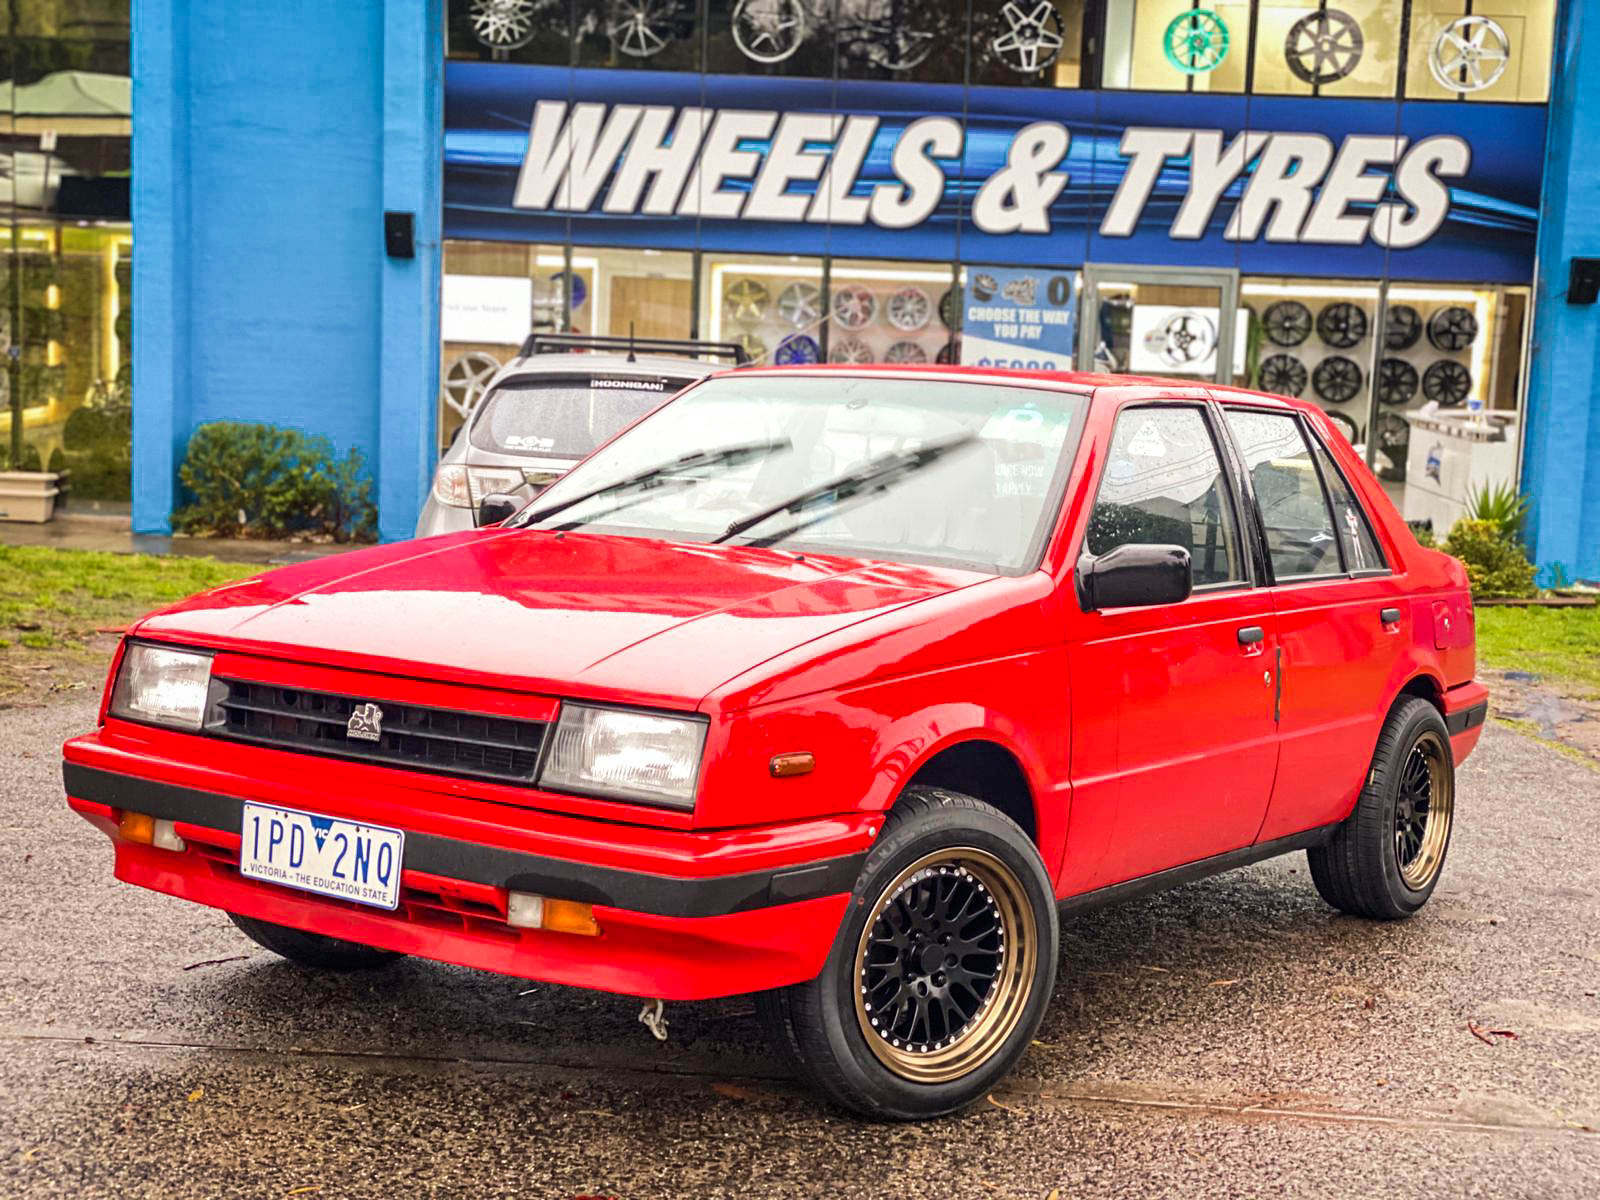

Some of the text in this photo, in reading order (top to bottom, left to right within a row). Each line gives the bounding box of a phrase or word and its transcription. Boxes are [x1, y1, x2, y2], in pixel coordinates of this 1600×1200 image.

[511, 99, 1471, 248] WHEELS & TYRES
[967, 306, 1070, 325] CHOOSE THE WAY
[993, 322, 1043, 339] YOU PAY
[313, 827, 329, 839] VIC
[253, 815, 393, 888] 1PD 2NQ
[250, 862, 287, 880] VICTORIA
[295, 874, 311, 885] THE
[313, 876, 360, 896] EDUCATION
[362, 887, 388, 902] STATE
